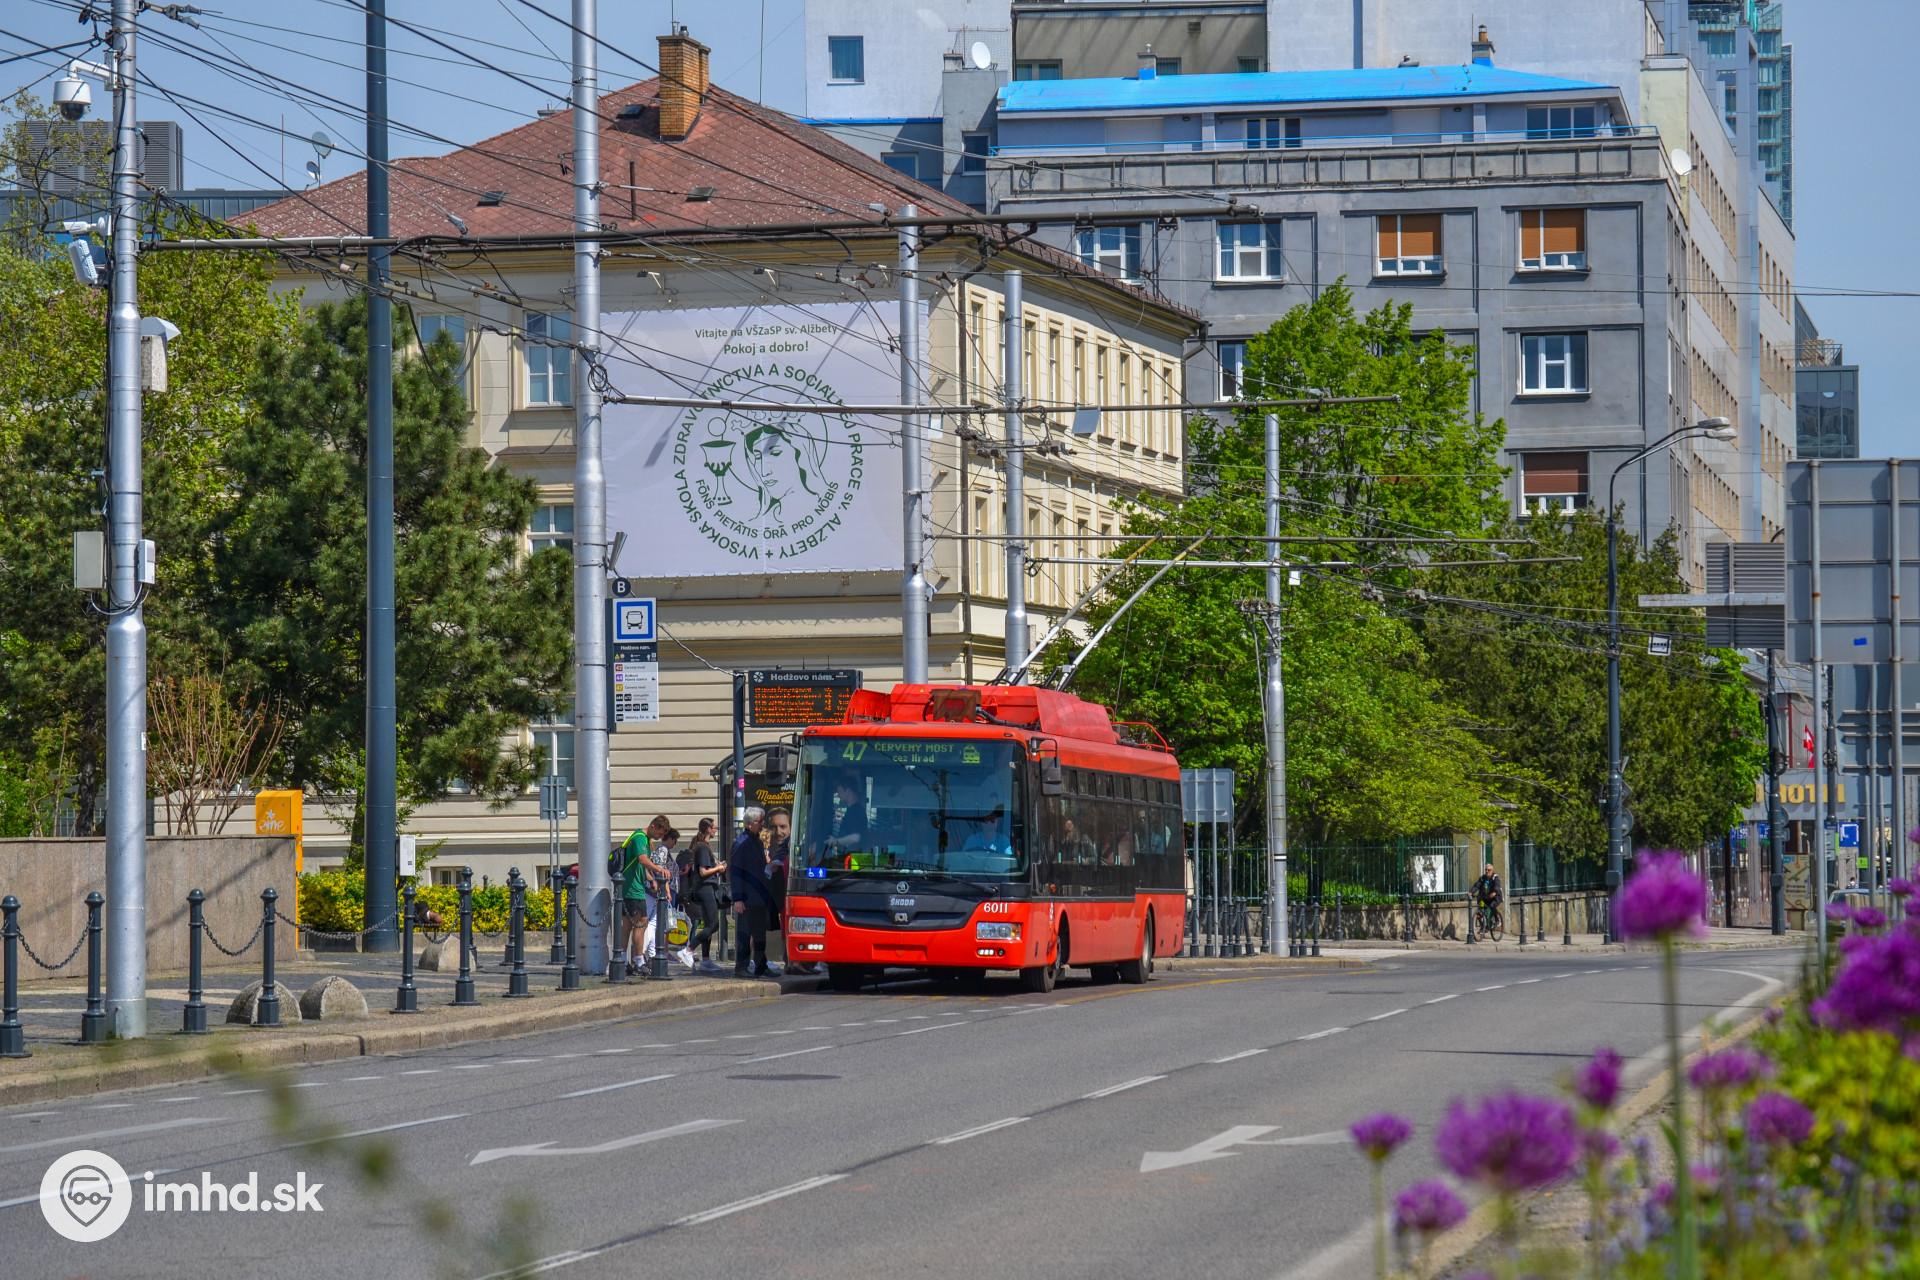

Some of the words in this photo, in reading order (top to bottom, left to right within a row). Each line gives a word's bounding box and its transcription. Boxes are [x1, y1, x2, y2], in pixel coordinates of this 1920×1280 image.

[695, 329, 728, 340] Vitajte
[731, 329, 743, 337] na
[745, 324, 782, 336] VŠZaSP
[784, 327, 798, 335] sv.
[800, 324, 838, 336] Alžbety
[723, 343, 756, 355] Pokoj
[759, 345, 766, 353] a
[769, 341, 809, 353] dobro!
[768, 363, 779, 376] A
[847, 433, 864, 491] PRÁCE
[674, 469, 702, 523] ŠKOLA
[838, 492, 854, 510] SV.
[791, 515, 814, 534] PRO
[698, 520, 759, 560] VYSOKÁ
[779, 513, 842, 559] ALŽBETY
[617, 581, 626, 593] B
[770, 672, 810, 681] Hodžovo
[811, 672, 835, 681] nám.
[842, 741, 868, 761] 47
[925, 743, 955, 753] MOST
[756, 788, 794, 802] Maestro
[983, 902, 1009, 914] 6011
